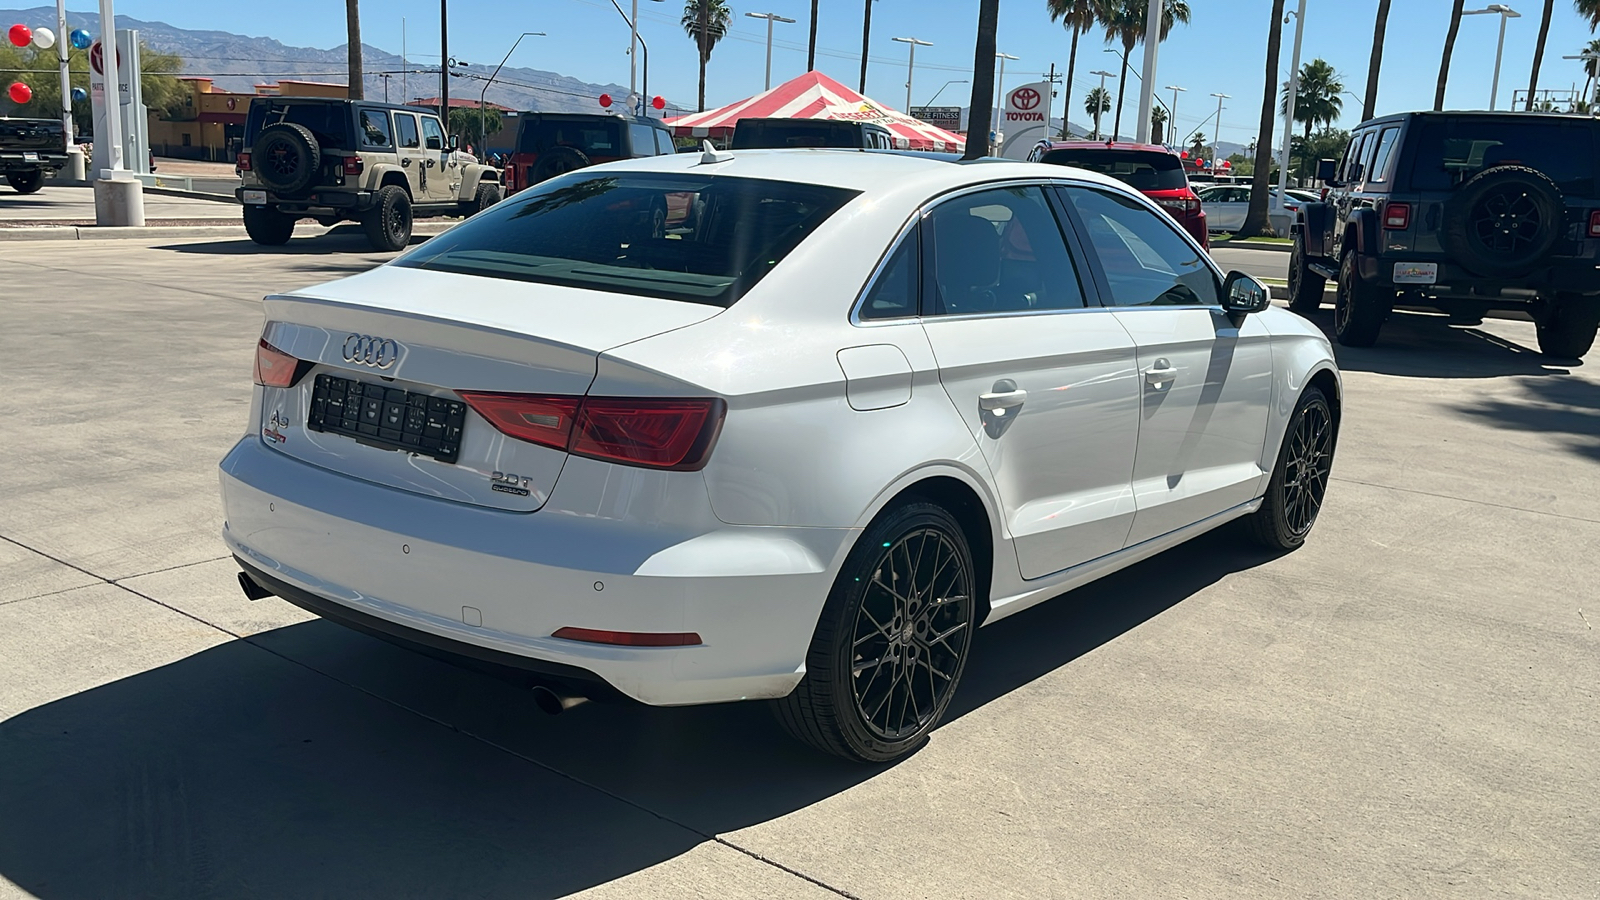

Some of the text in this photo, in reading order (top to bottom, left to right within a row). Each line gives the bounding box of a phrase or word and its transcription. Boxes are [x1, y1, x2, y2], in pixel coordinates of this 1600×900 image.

[832, 109, 882, 120] DESERT
[1005, 112, 1044, 121] TOYOTA
[270, 409, 289, 428] A3
[492, 485, 529, 495] quattro
